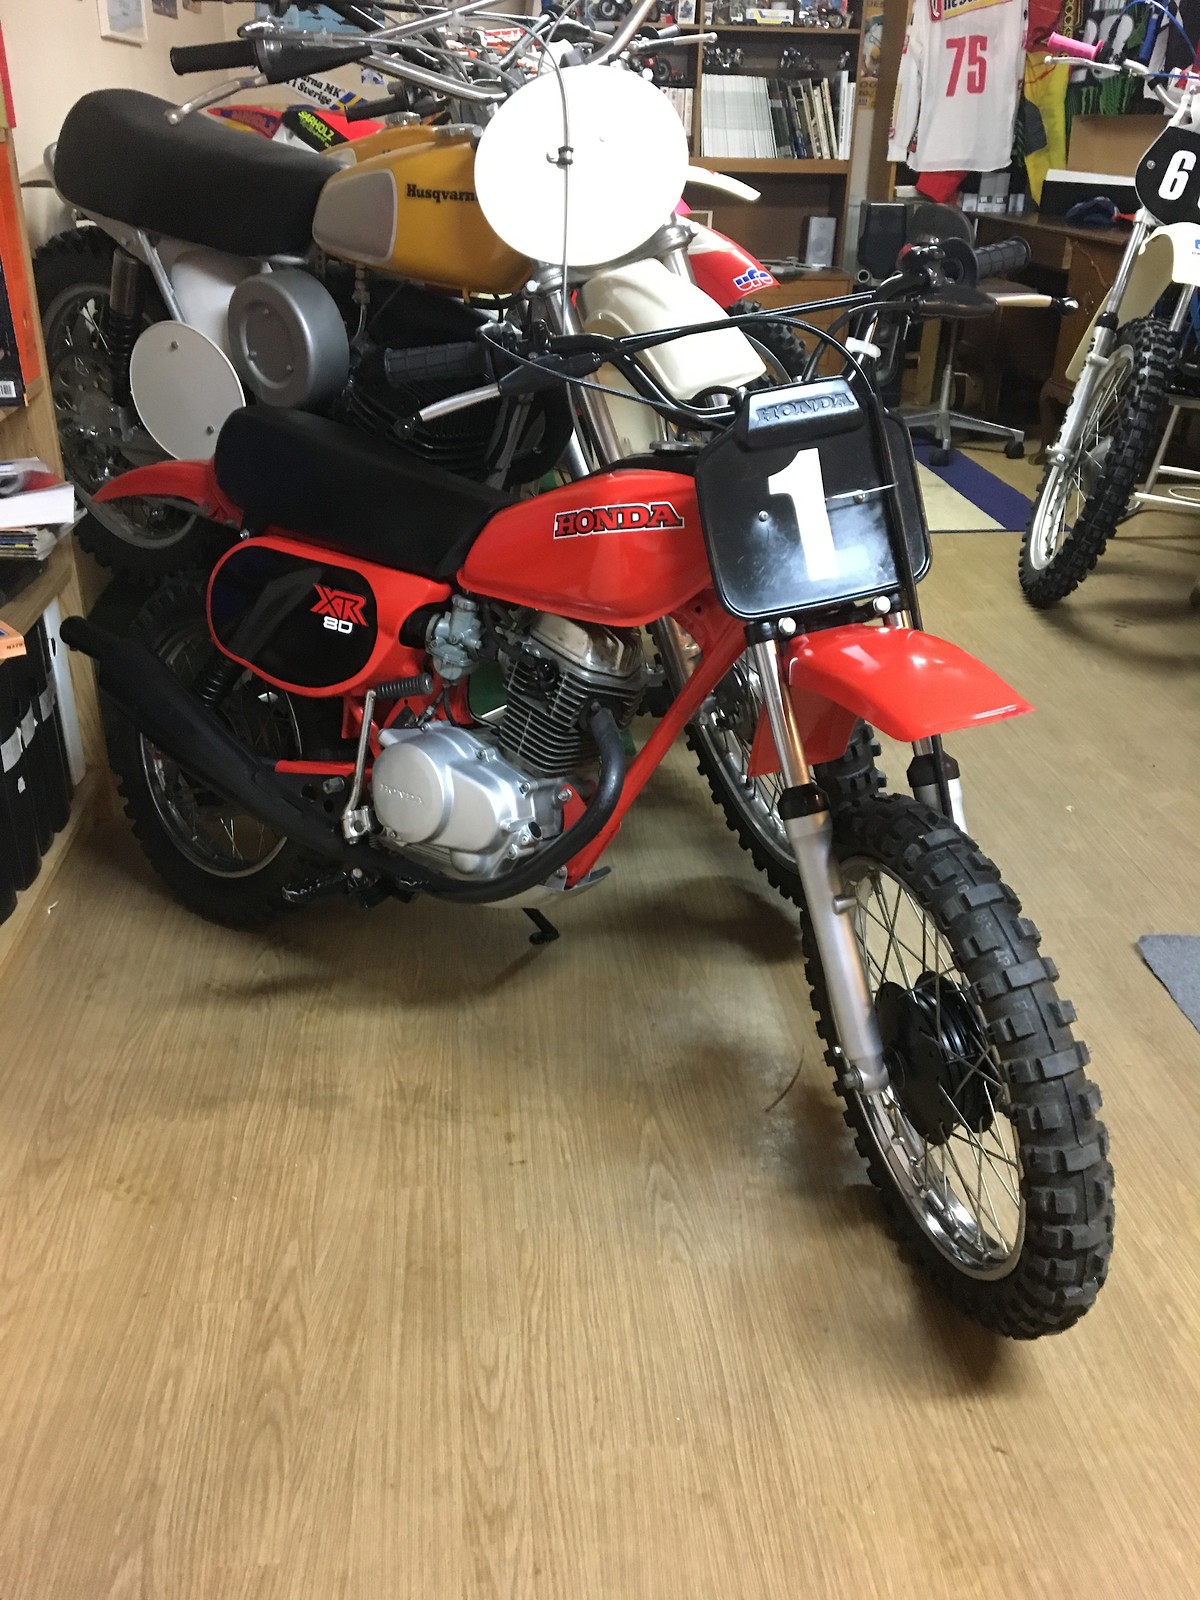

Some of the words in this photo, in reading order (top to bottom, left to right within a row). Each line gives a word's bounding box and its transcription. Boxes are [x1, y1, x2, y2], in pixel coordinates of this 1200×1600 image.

[945, 35, 988, 97] 75
[298, 81, 332, 105] Sverige
[324, 80, 342, 98] MK
[406, 183, 478, 203] Husqvarn
[1158, 150, 1200, 208] 6
[756, 393, 855, 422] HONDA
[554, 502, 685, 539] HONDA
[768, 447, 840, 581] 1
[310, 583, 369, 627] XR
[323, 616, 353, 634] 80
